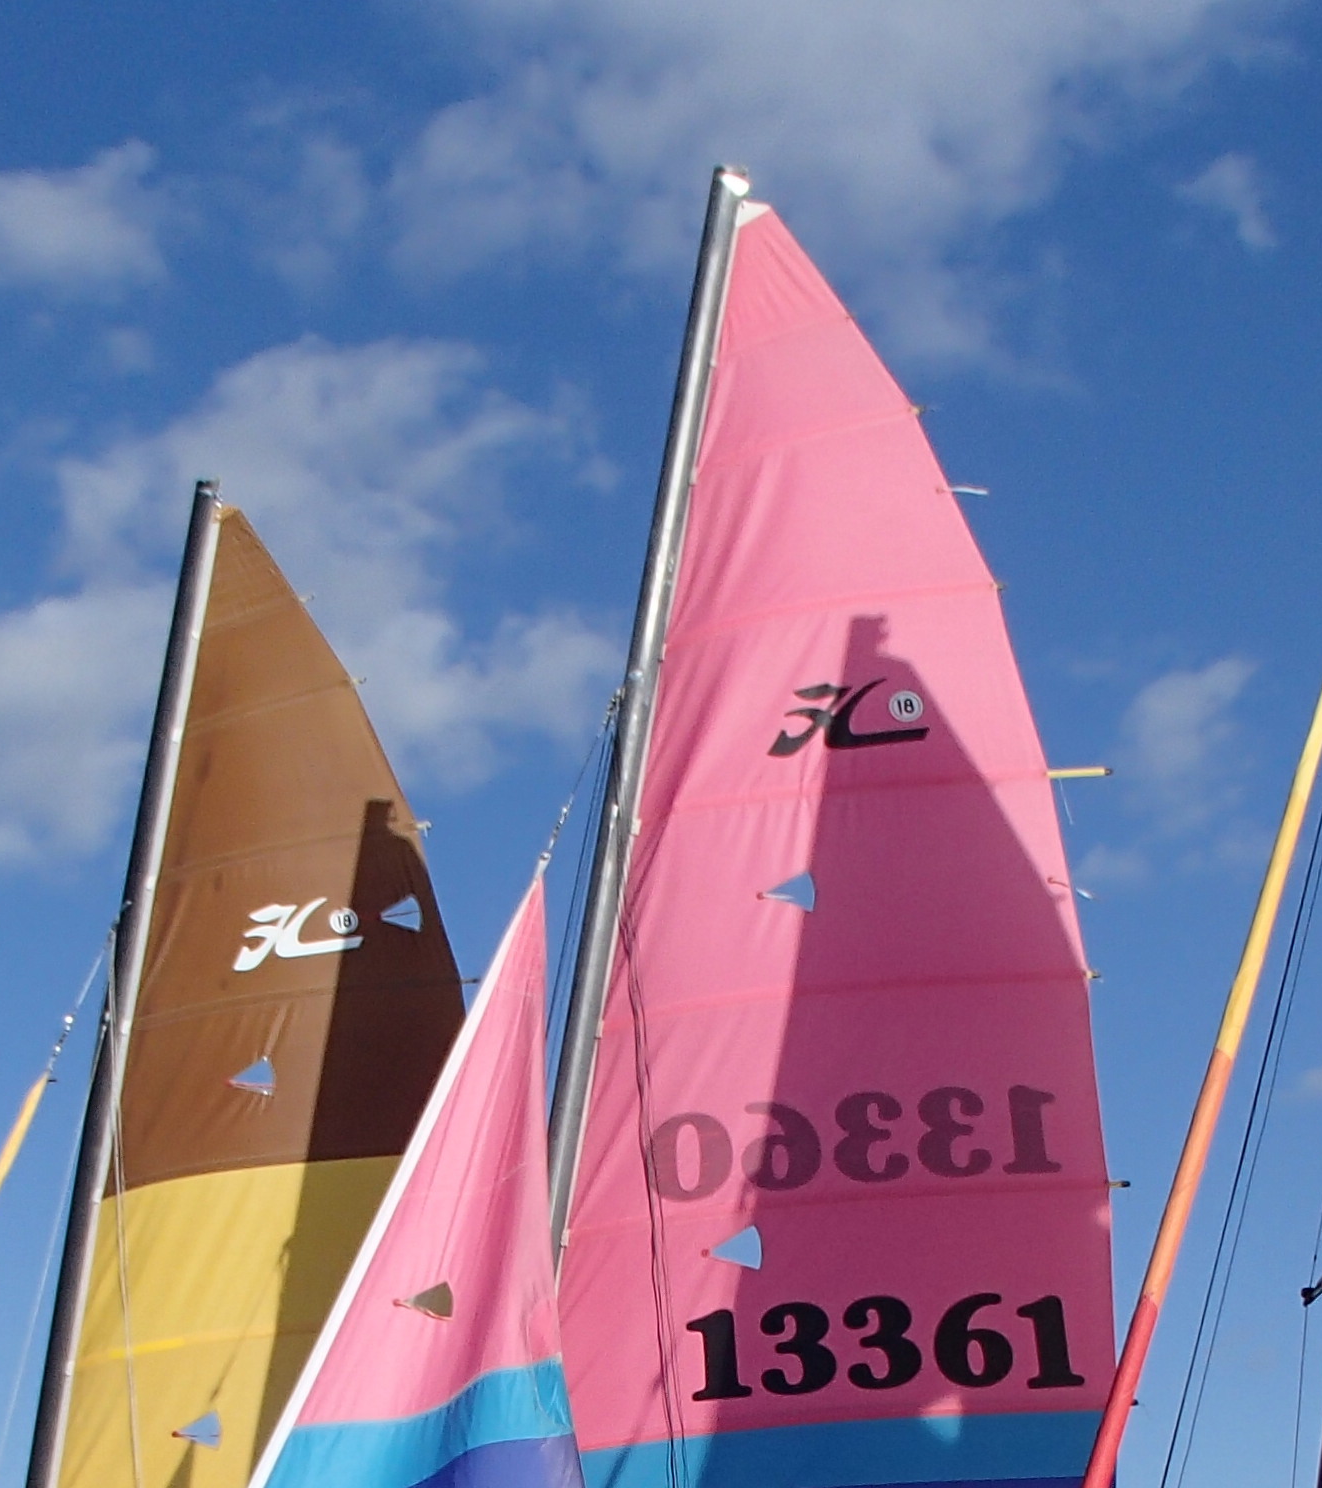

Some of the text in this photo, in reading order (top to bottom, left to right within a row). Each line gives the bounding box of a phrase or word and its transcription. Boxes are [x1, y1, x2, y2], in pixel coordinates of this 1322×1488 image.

[896, 698, 915, 716] 18
[336, 912, 352, 930] 18
[685, 1292, 1086, 1402] 13361
